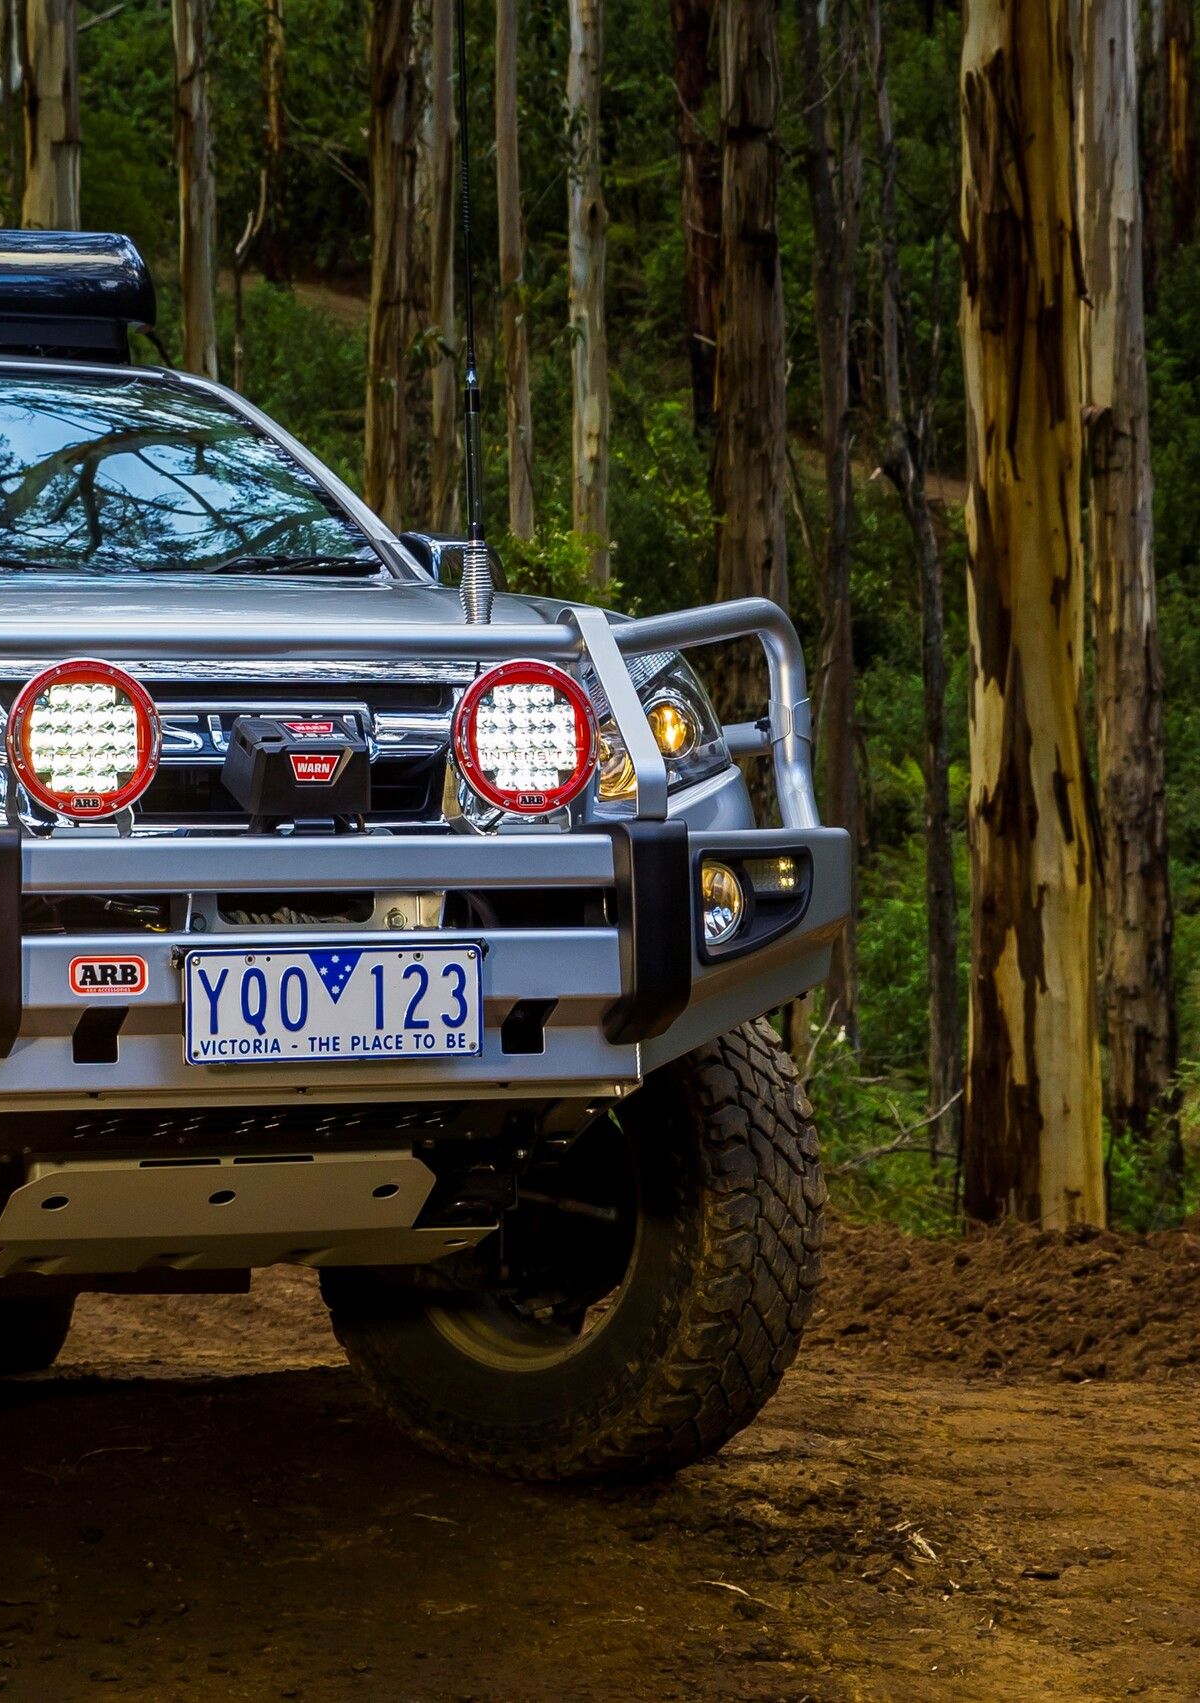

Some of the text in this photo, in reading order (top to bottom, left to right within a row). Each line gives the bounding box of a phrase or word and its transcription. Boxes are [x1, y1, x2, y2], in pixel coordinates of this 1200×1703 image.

[297, 763, 330, 773] WARN
[74, 798, 100, 808] ARB
[521, 795, 544, 805] ARB
[79, 964, 138, 986] ARB
[369, 963, 468, 1030] 123
[200, 1037, 282, 1056] VICTORIA
[308, 1036, 341, 1052] THE
[351, 1034, 403, 1051] PLACE
[413, 1033, 436, 1050] TO
[446, 1033, 467, 1049] BE
